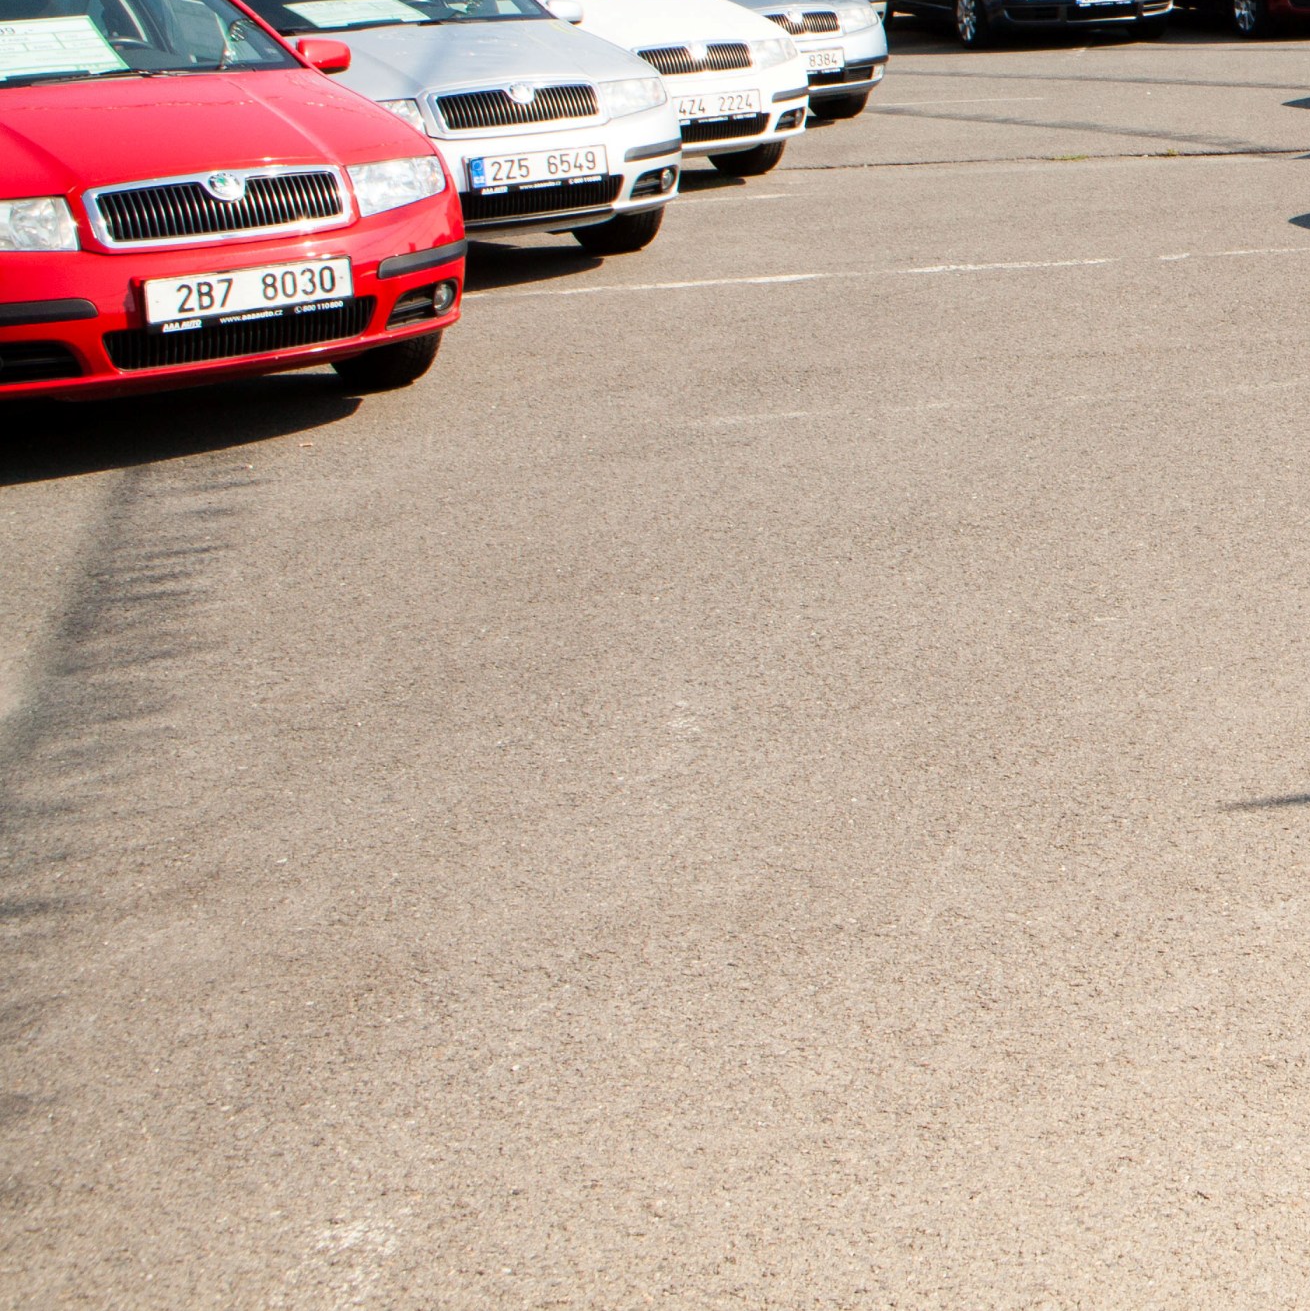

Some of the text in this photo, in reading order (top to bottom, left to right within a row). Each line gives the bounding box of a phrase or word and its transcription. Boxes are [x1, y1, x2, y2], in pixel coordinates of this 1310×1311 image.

[809, 53, 838, 68] 8384
[679, 94, 753, 116] 4Z4 2224
[491, 157, 530, 182] 2Z5
[547, 150, 596, 175] 6549
[176, 265, 336, 314] 2B7 8030
